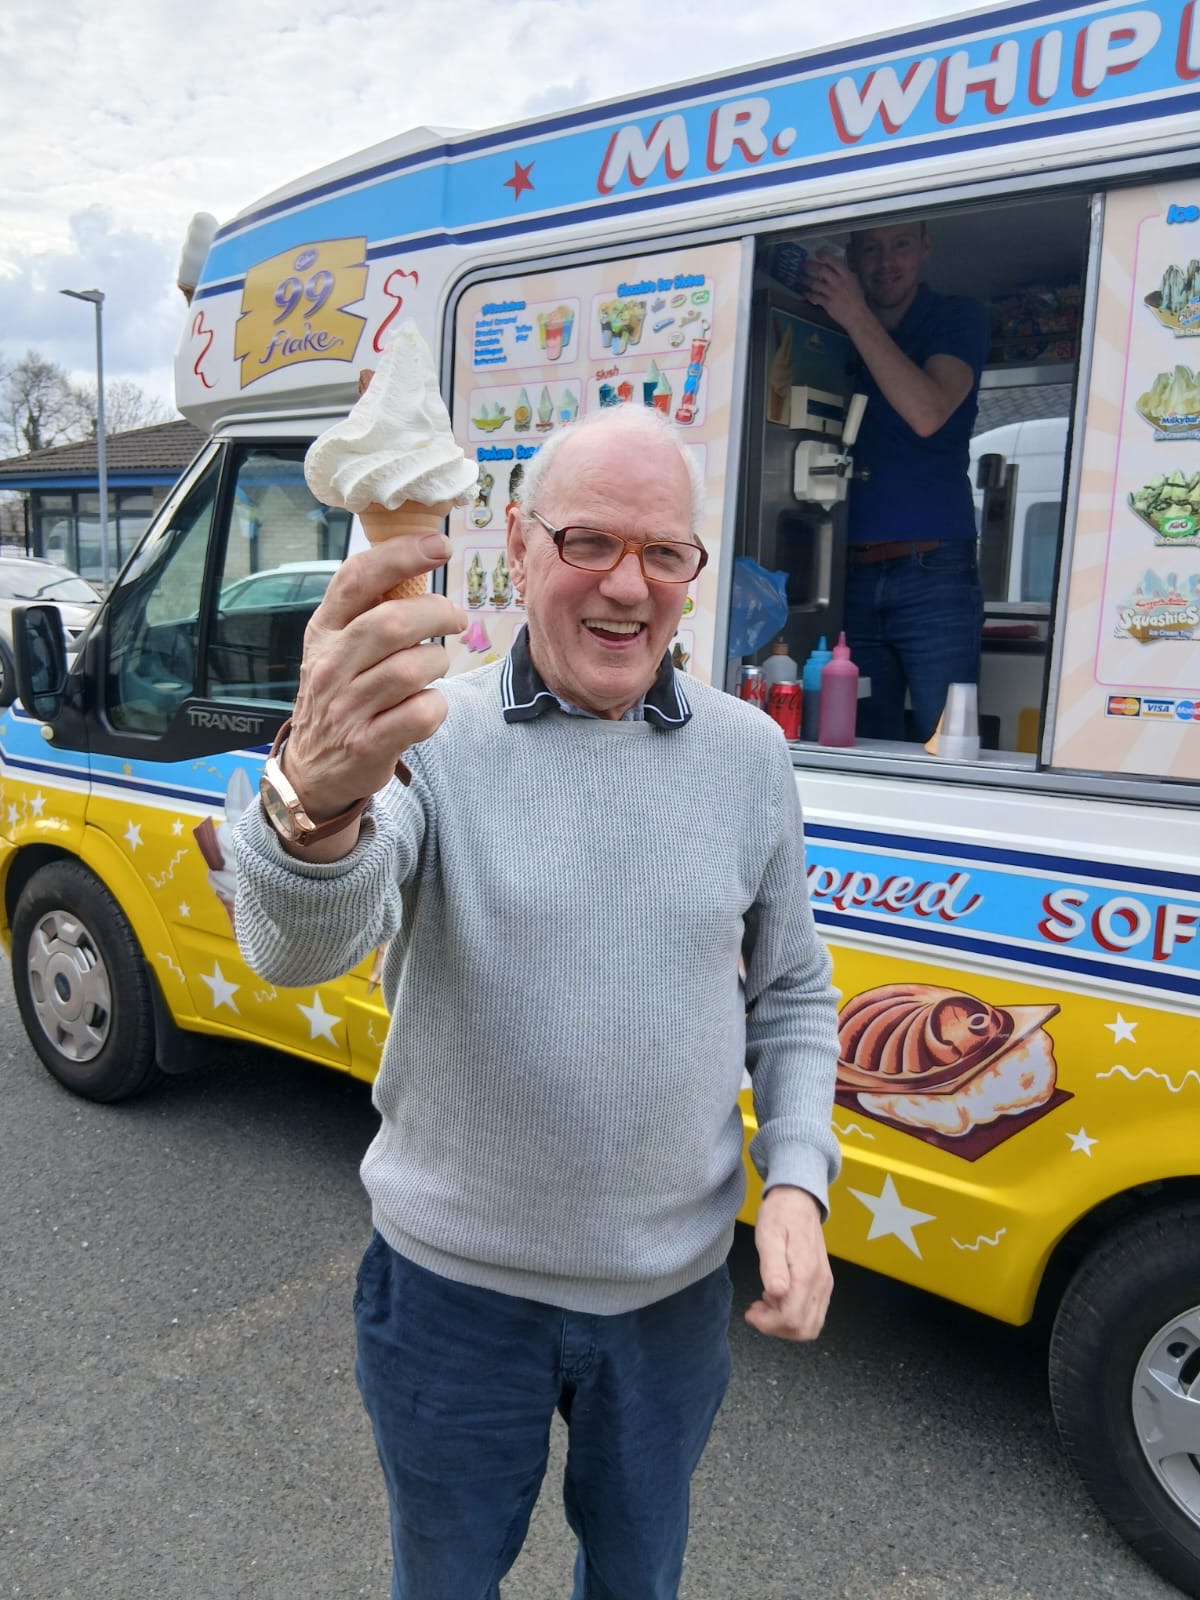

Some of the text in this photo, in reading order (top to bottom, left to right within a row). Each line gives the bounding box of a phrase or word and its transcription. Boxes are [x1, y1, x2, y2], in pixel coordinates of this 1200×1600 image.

[597, 98, 797, 194] MR.
[273, 270, 335, 325] 99
[595, 365, 620, 381] Slush
[1161, 415, 1197, 425] Milkybar
[1147, 704, 1170, 713] VISA
[187, 710, 265, 734] TRANSIT
[806, 864, 984, 921] pped
